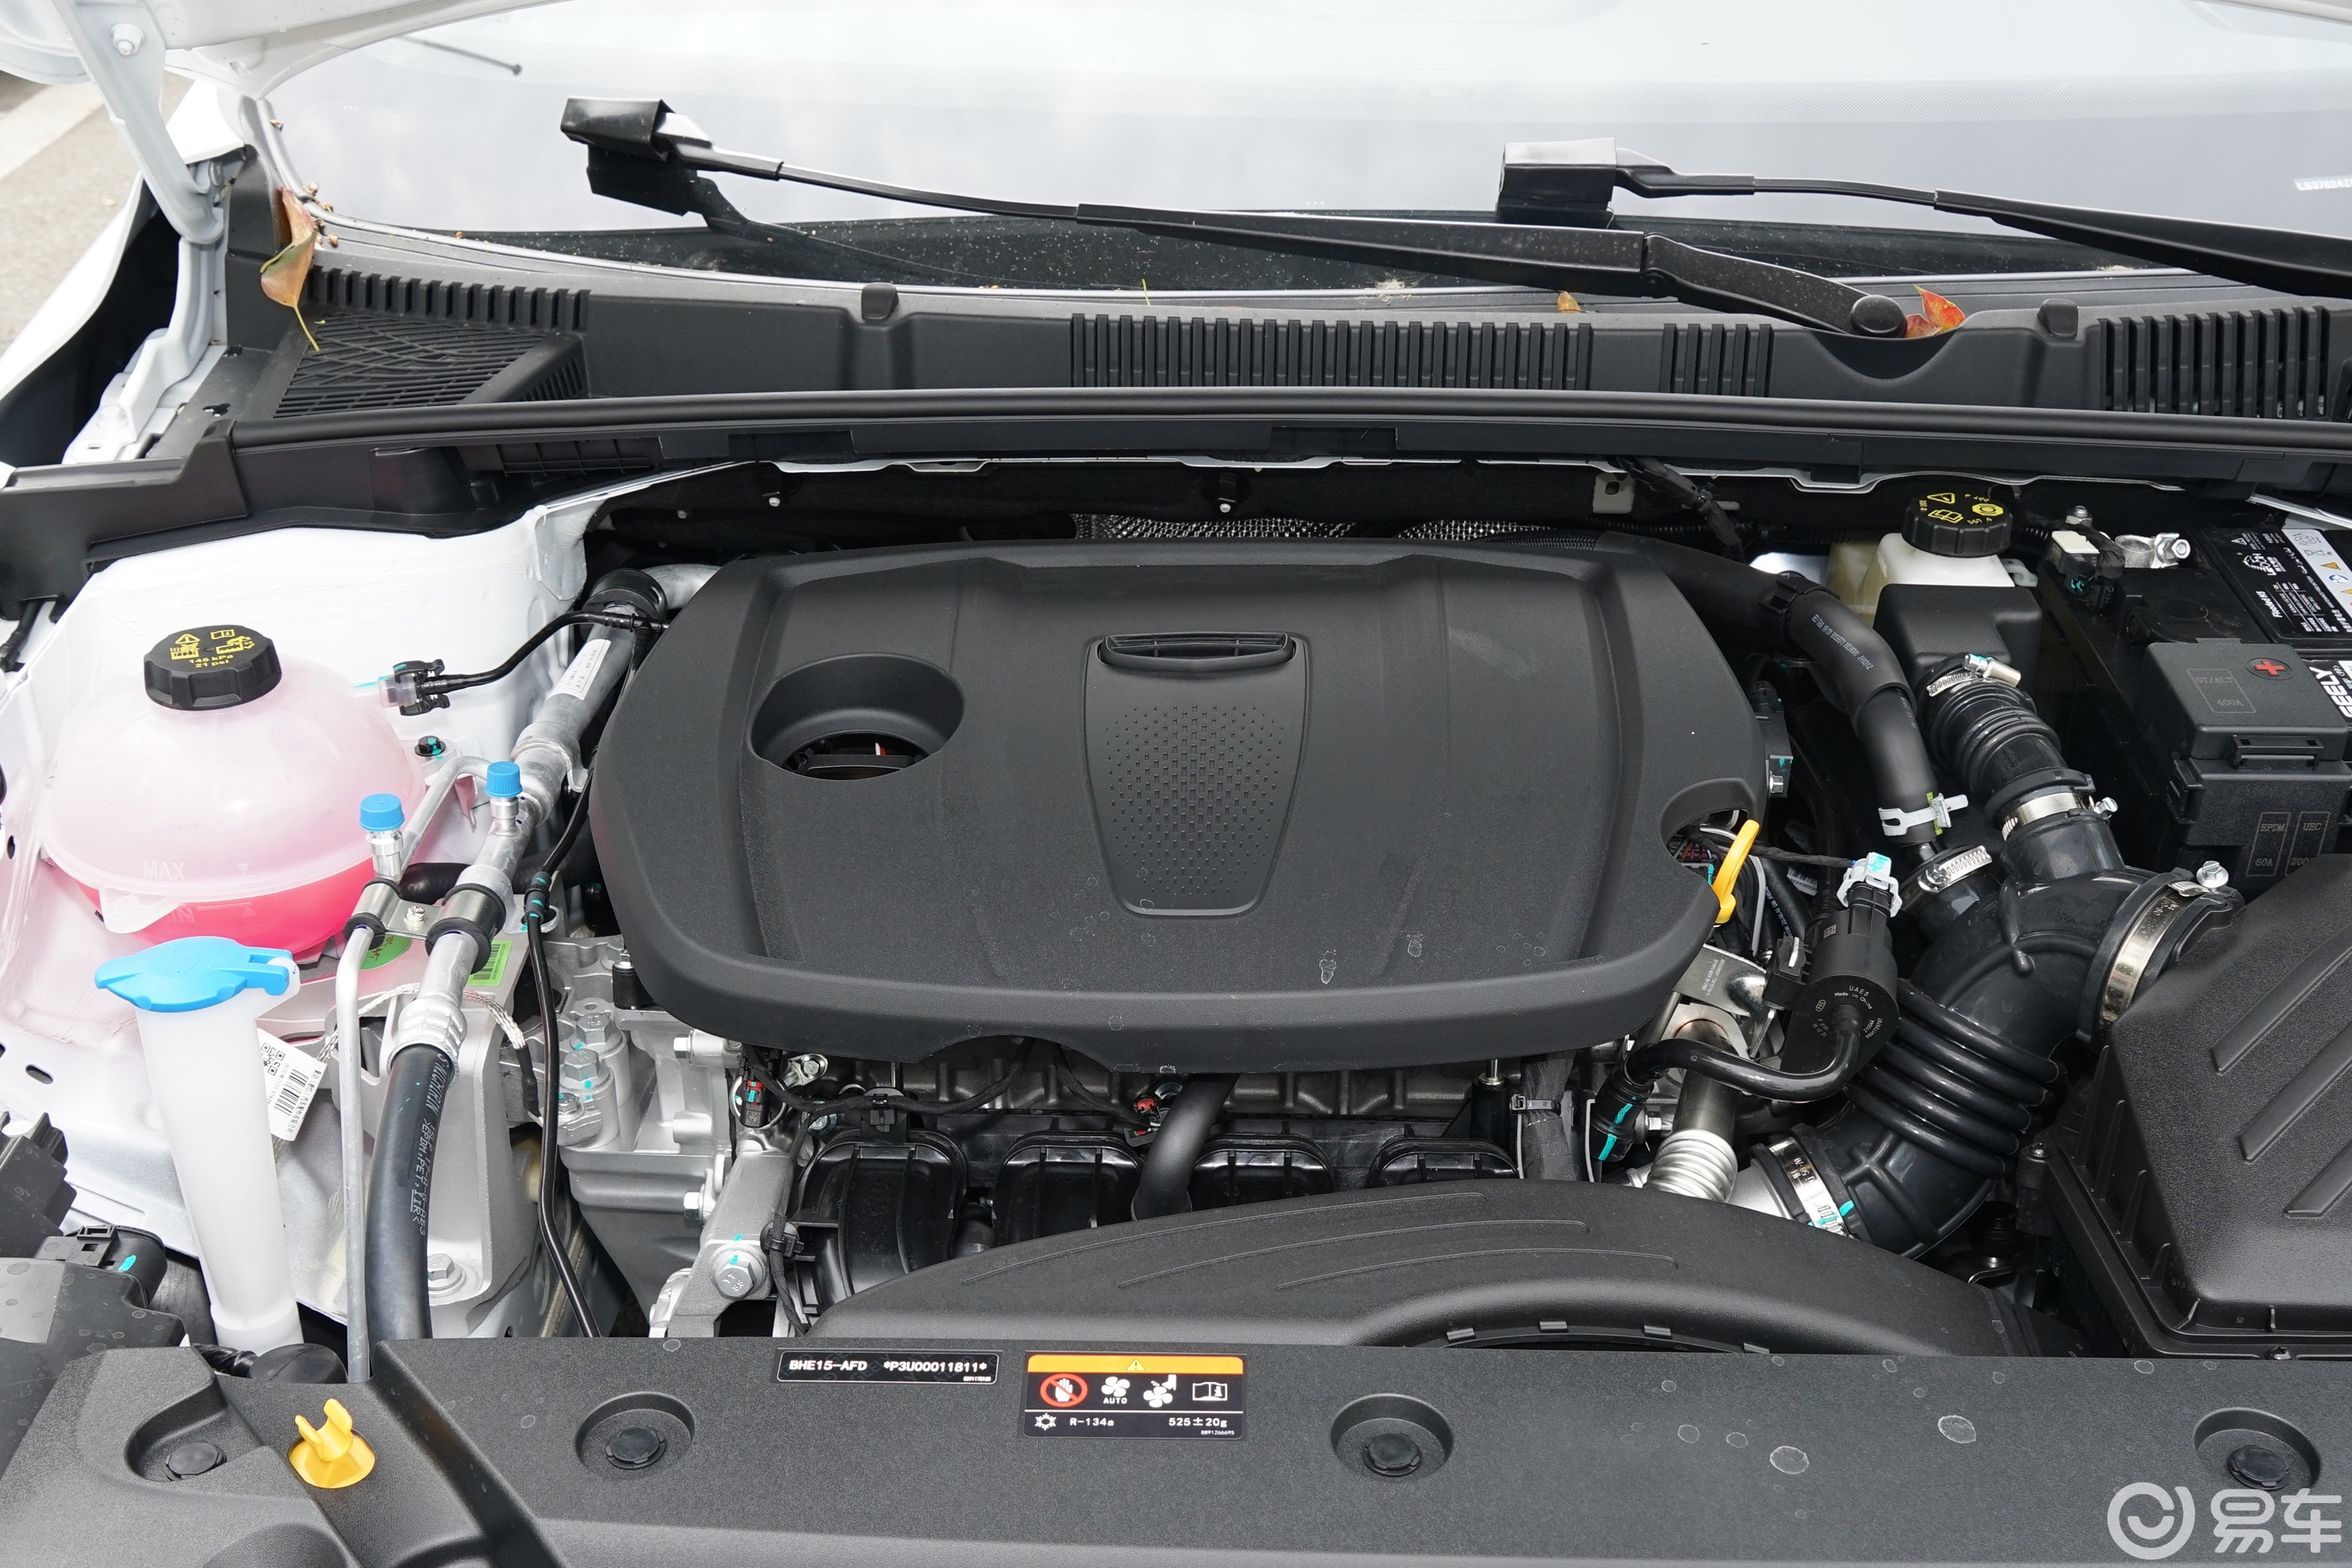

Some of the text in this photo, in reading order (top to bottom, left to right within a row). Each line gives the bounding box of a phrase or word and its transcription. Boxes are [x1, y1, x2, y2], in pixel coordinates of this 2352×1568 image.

[2260, 823, 2285, 832] EPDM
[2290, 857, 2314, 866] 200
[143, 860, 186, 880] MAX
[165, 907, 195, 923] IN
[1849, 985, 1870, 996] UAES
[789, 1359, 868, 1371] BHE15-AFD
[1069, 1417, 1114, 1427] R-134a
